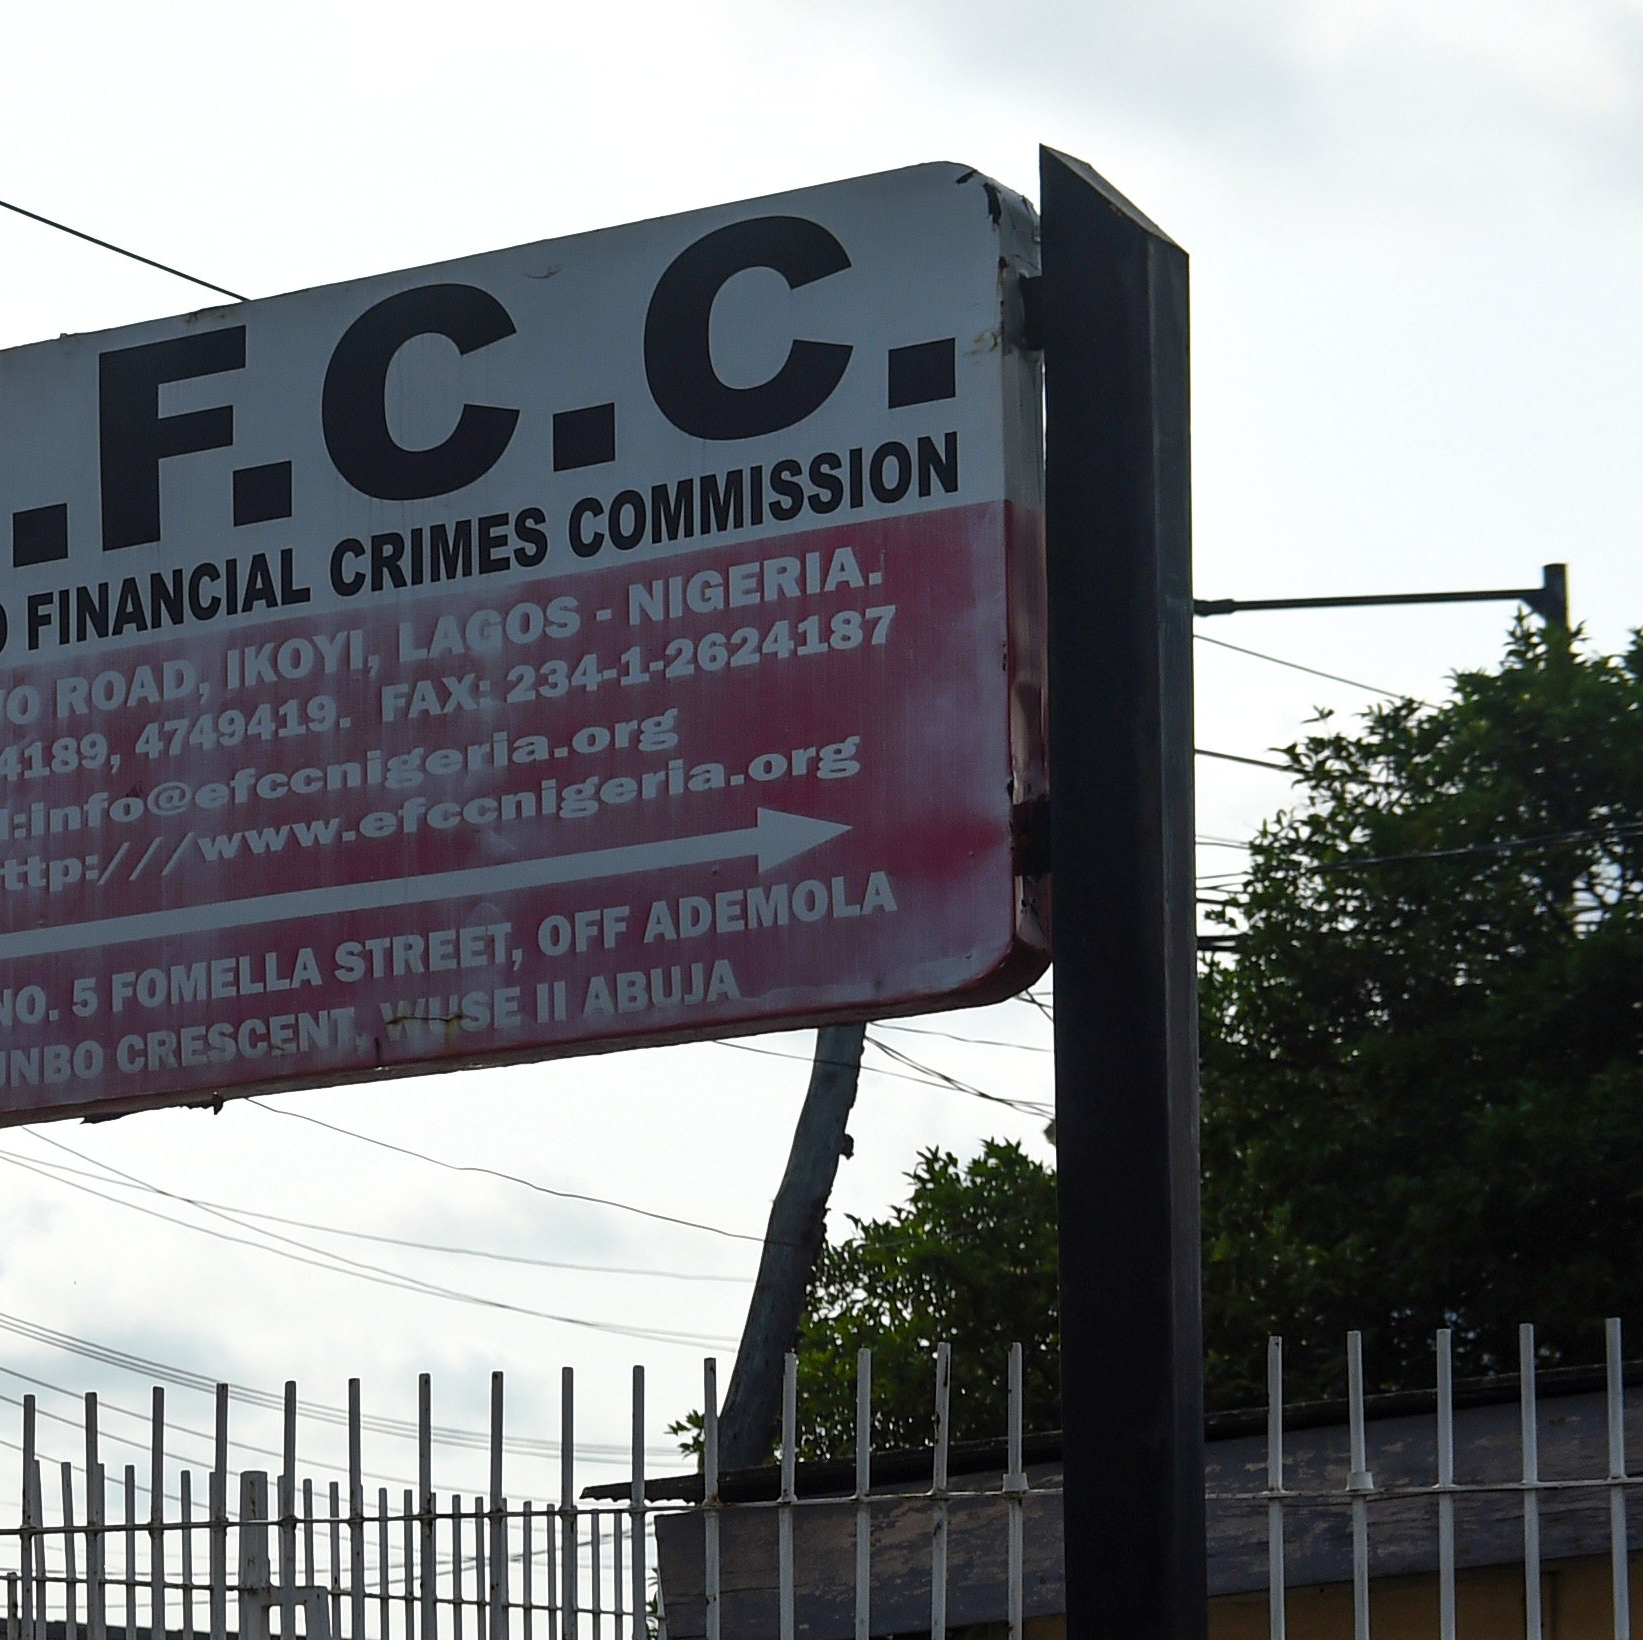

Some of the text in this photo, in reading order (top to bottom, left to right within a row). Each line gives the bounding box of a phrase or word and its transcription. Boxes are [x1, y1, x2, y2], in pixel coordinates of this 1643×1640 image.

[27, 547, 312, 651] FINANCIAL
[329, 507, 549, 598] CRIMES
[568, 430, 959, 558] COMMISSION
[56, 657, 210, 719] ROAD,
[225, 629, 379, 690] IKOYI,
[398, 596, 582, 661] LAGOS
[595, 608, 613, 621] -
[629, 546, 883, 625] NIGERIA.
[134, 695, 351, 760] 4749419.
[380, 673, 492, 724] FAX:
[506, 604, 898, 703] 234-1-2624187
[71, 979, 98, 1019] 5
[111, 946, 322, 1013] FOMELLA
[334, 922, 523, 984] STREET,
[537, 905, 631, 958] OFF
[642, 869, 899, 946] ADEMOLA
[116, 1007, 368, 1072] CRESCENT,
[377, 987, 523, 1043] WUSE
[535, 981, 568, 1024] II
[585, 958, 742, 1020] ABUJA
